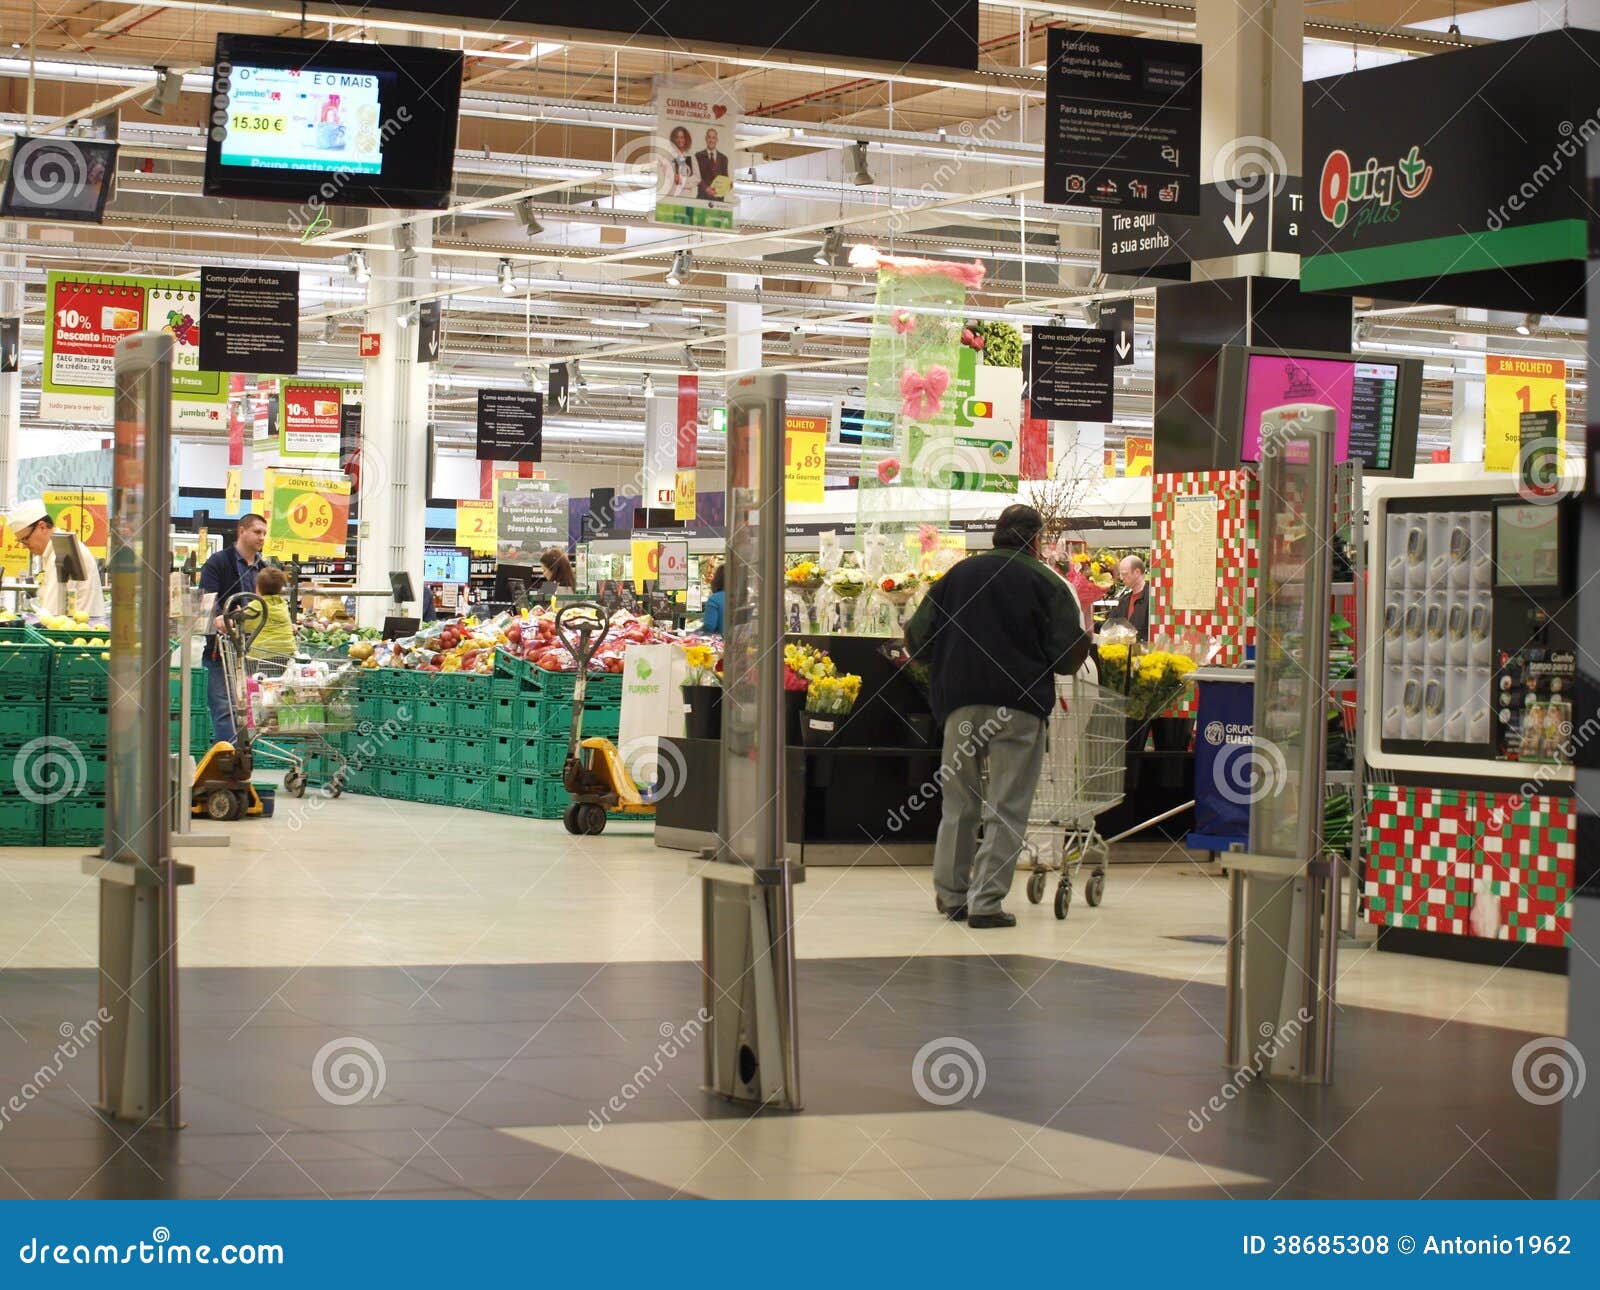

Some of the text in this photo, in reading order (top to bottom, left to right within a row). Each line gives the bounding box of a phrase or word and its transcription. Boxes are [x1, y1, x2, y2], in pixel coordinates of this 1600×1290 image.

[1061, 40, 1099, 53] Horários
[1061, 67, 1095, 78] Domingos
[326, 75, 336, 86] O
[340, 76, 372, 88] MAIS
[666, 98, 709, 111] CUIDAMOS
[1060, 104, 1133, 120] Para sua protecção
[232, 116, 283, 131] 15.30 €
[1112, 213, 1156, 232] Tire aqui
[1353, 200, 1402, 238] plus
[1289, 222, 1298, 236] a
[1111, 234, 1169, 255] a sua senha
[206, 274, 280, 286] Como escolher frutas
[57, 309, 92, 330] 10%
[56, 329, 127, 344] Desconto Imedi
[1037, 333, 1106, 344] Como escolher legumes
[56, 355, 73, 363] TAEG
[74, 356, 99, 364] máxima
[65, 363, 90, 371] crédito:
[1500, 360, 1553, 374] EM FOLHETO
[179, 408, 206, 418] jumbo
[287, 403, 309, 416] 10%
[287, 416, 339, 425] Desconto Imediato
[786, 419, 816, 430] OLHETO
[812, 443, 819, 455] €
[288, 479, 309, 487] COUVE
[1225, 734, 1255, 745] EULEN
